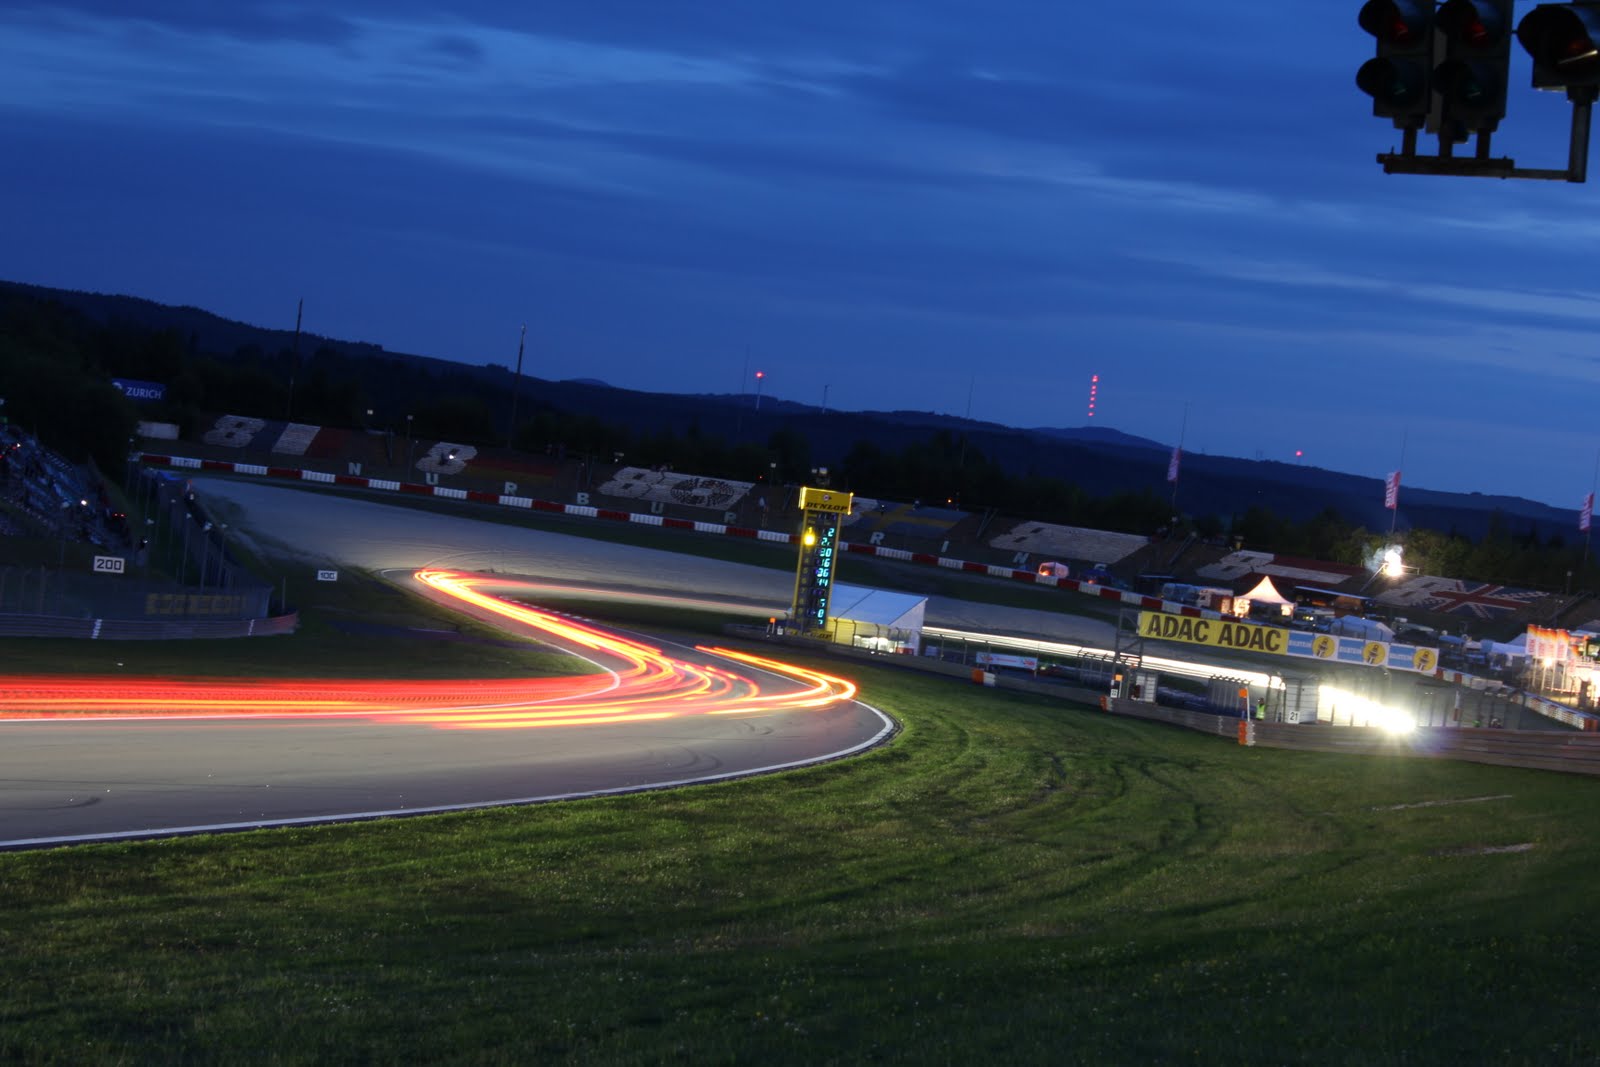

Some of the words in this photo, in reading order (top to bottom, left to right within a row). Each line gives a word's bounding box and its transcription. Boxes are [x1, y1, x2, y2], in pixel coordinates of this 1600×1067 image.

[126, 386, 162, 400] ZURICH
[348, 462, 362, 475] N
[504, 482, 518, 495] R
[577, 492, 590, 505] B
[869, 532, 885, 545] R
[805, 502, 848, 511] DUNLOP
[96, 558, 122, 571] 200
[1147, 614, 1210, 643] ADAC
[1217, 624, 1282, 652] ADAC
[1289, 711, 1299, 721] 21
